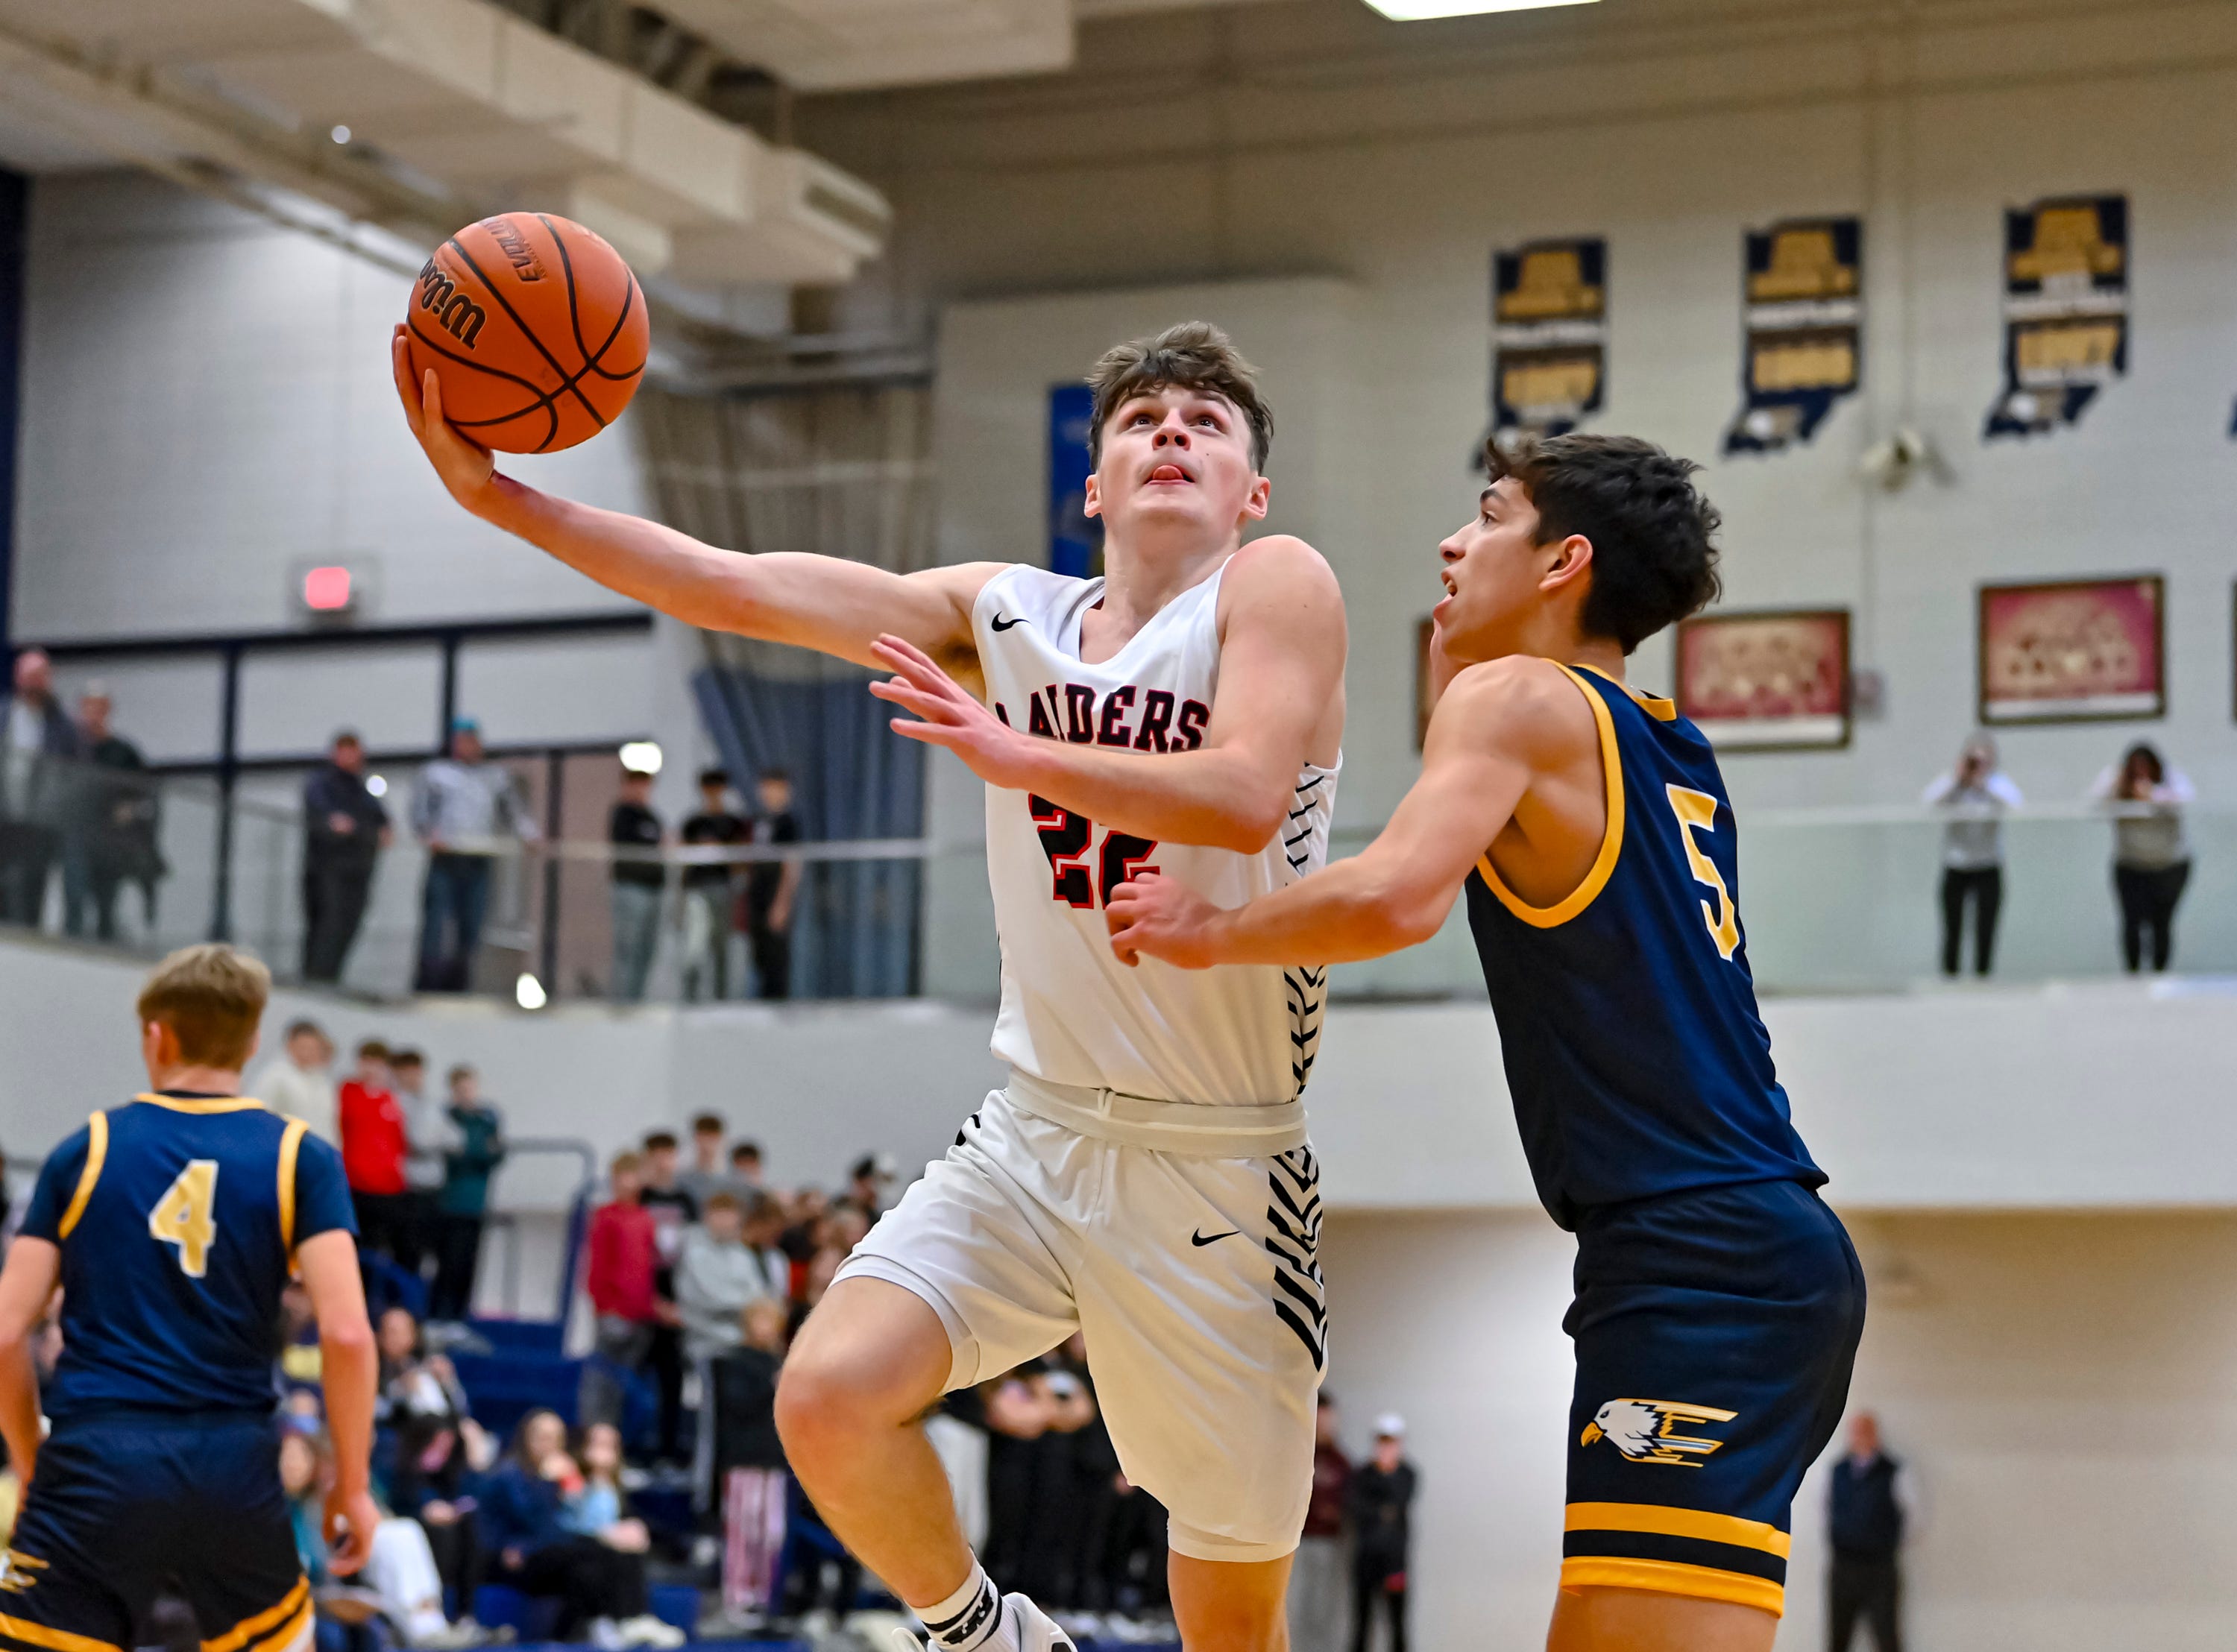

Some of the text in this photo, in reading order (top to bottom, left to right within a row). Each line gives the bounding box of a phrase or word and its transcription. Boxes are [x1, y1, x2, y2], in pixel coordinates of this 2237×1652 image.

[995, 682, 1211, 754] AIDERS
[1665, 783, 1740, 962] 5
[148, 1158, 219, 1279] 4
